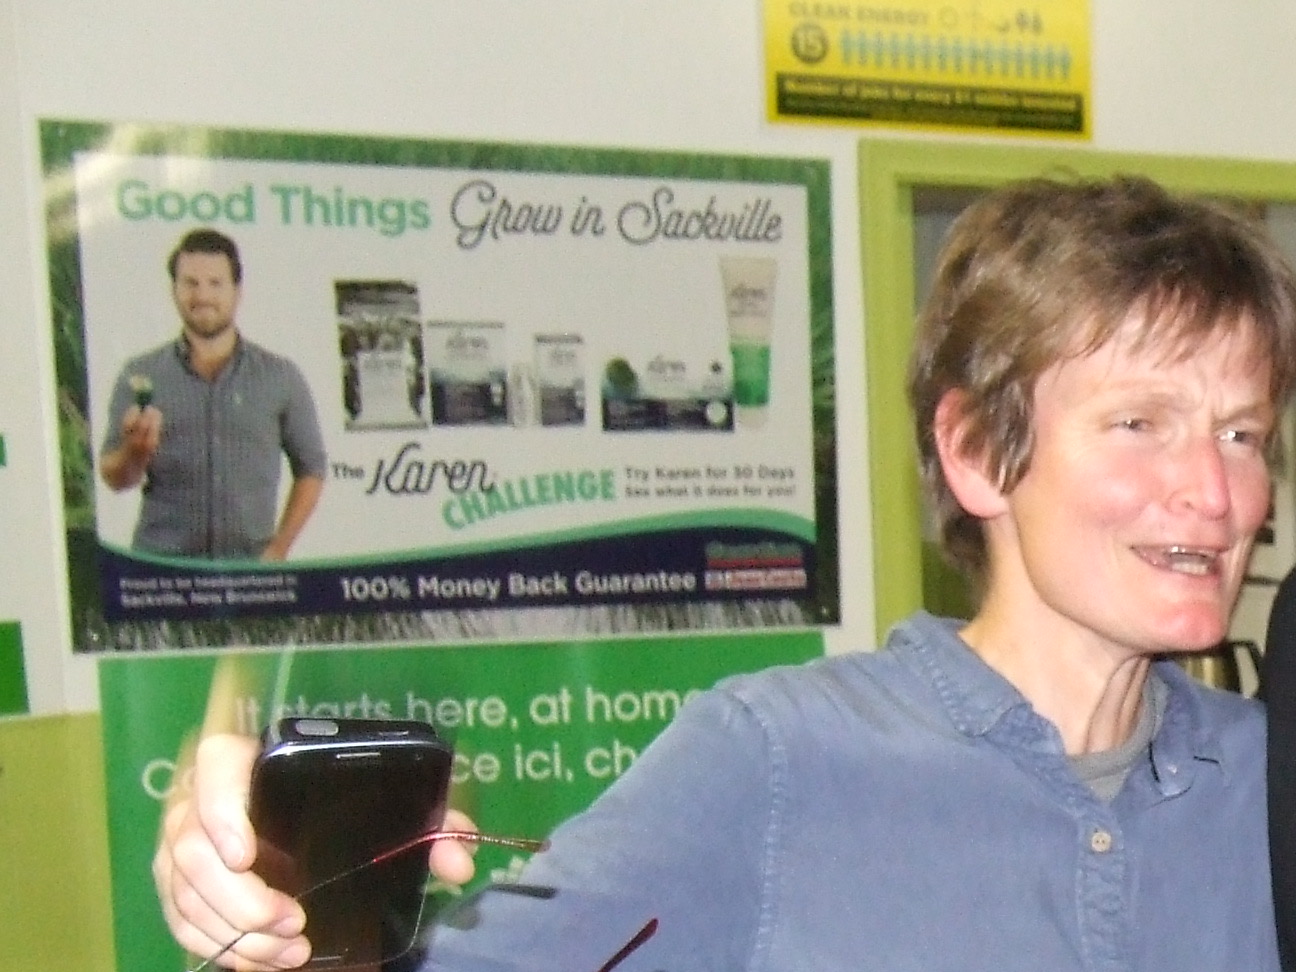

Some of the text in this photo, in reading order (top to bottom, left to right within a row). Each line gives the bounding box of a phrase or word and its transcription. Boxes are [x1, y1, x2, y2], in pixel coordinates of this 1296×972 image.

[117, 179, 783, 249] Good Things Grow in Sackville
[366, 441, 495, 495] Karen
[442, 468, 617, 530] CHALLENGE
[341, 576, 411, 601] 100%
[417, 575, 501, 600] Money
[508, 572, 568, 596] Back
[574, 570, 696, 595] Guarantee
[529, 686, 572, 725] at
[515, 743, 574, 782] ici,
